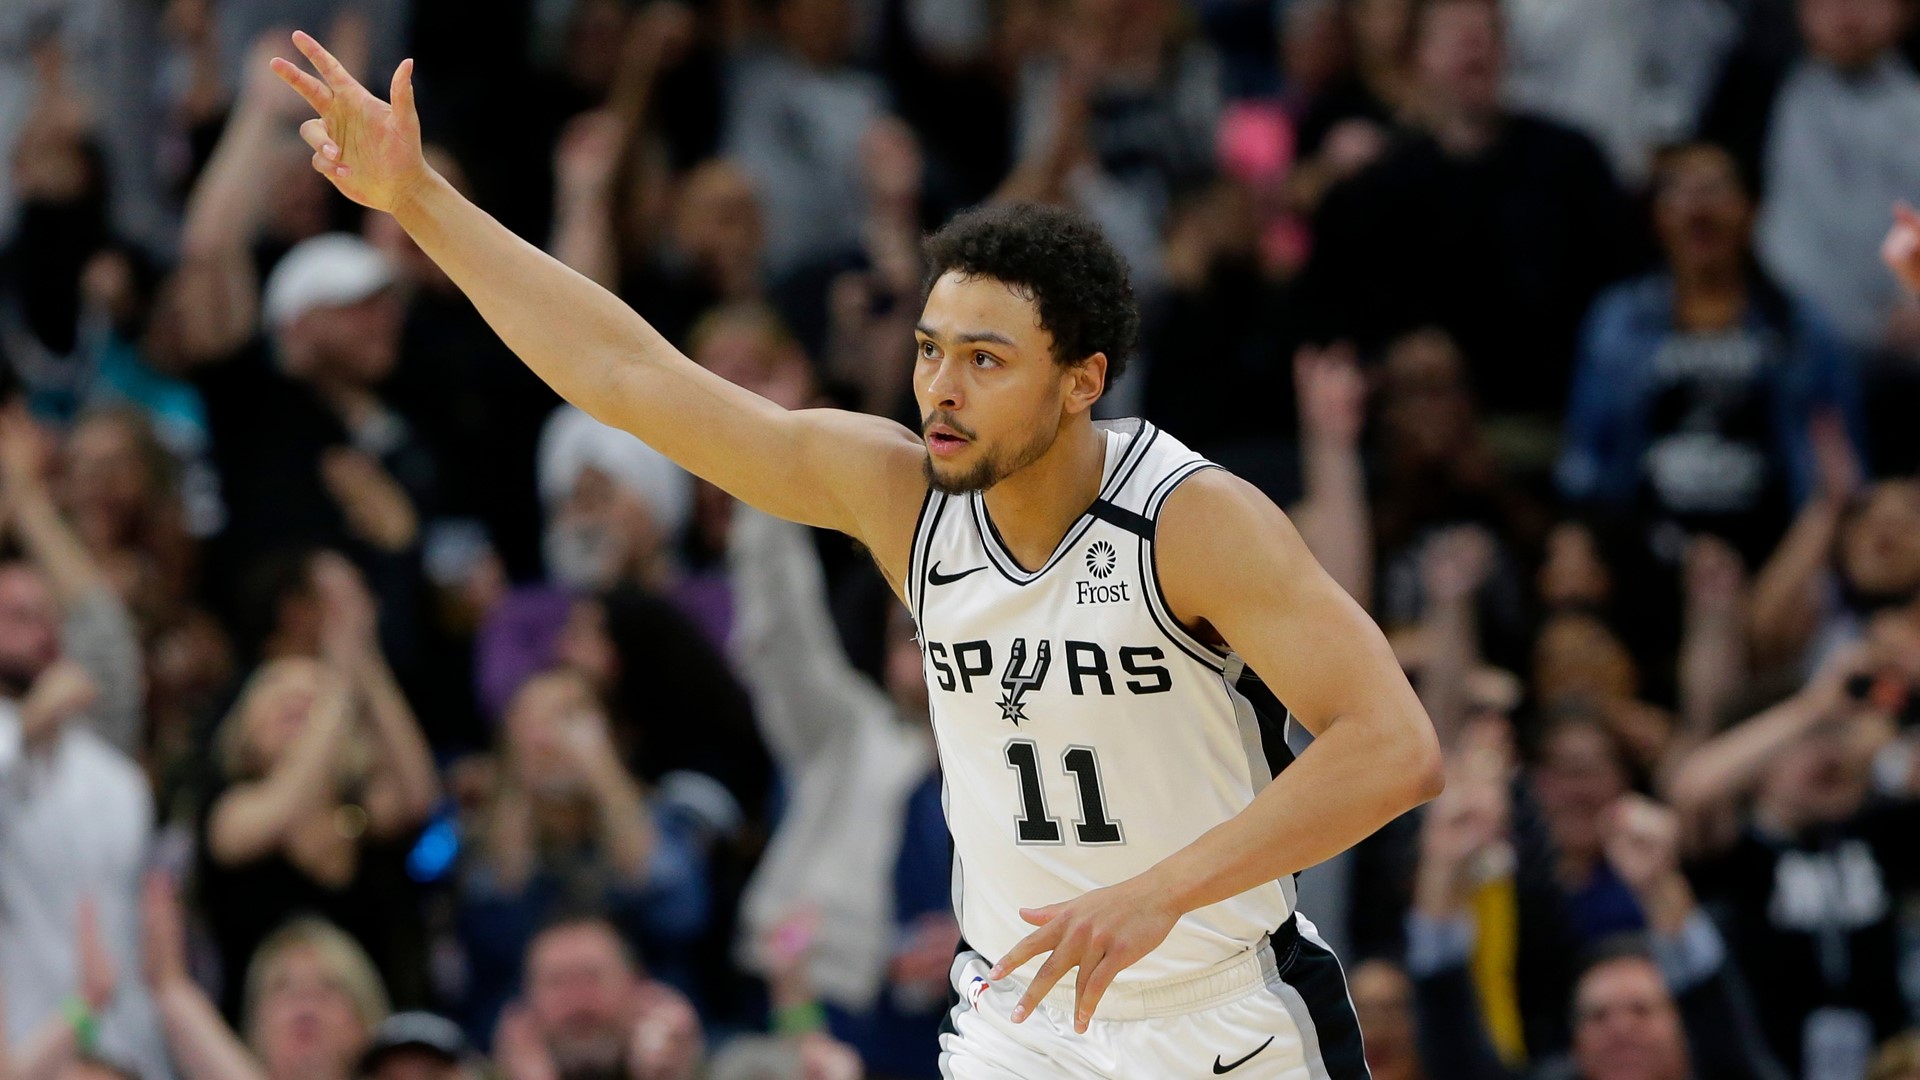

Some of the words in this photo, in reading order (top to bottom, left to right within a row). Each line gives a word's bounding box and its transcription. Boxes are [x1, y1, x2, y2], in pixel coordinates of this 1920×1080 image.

[1076, 580, 1130, 605] Frost
[928, 637, 1173, 727] SPURS
[1003, 738, 1127, 847] 11
